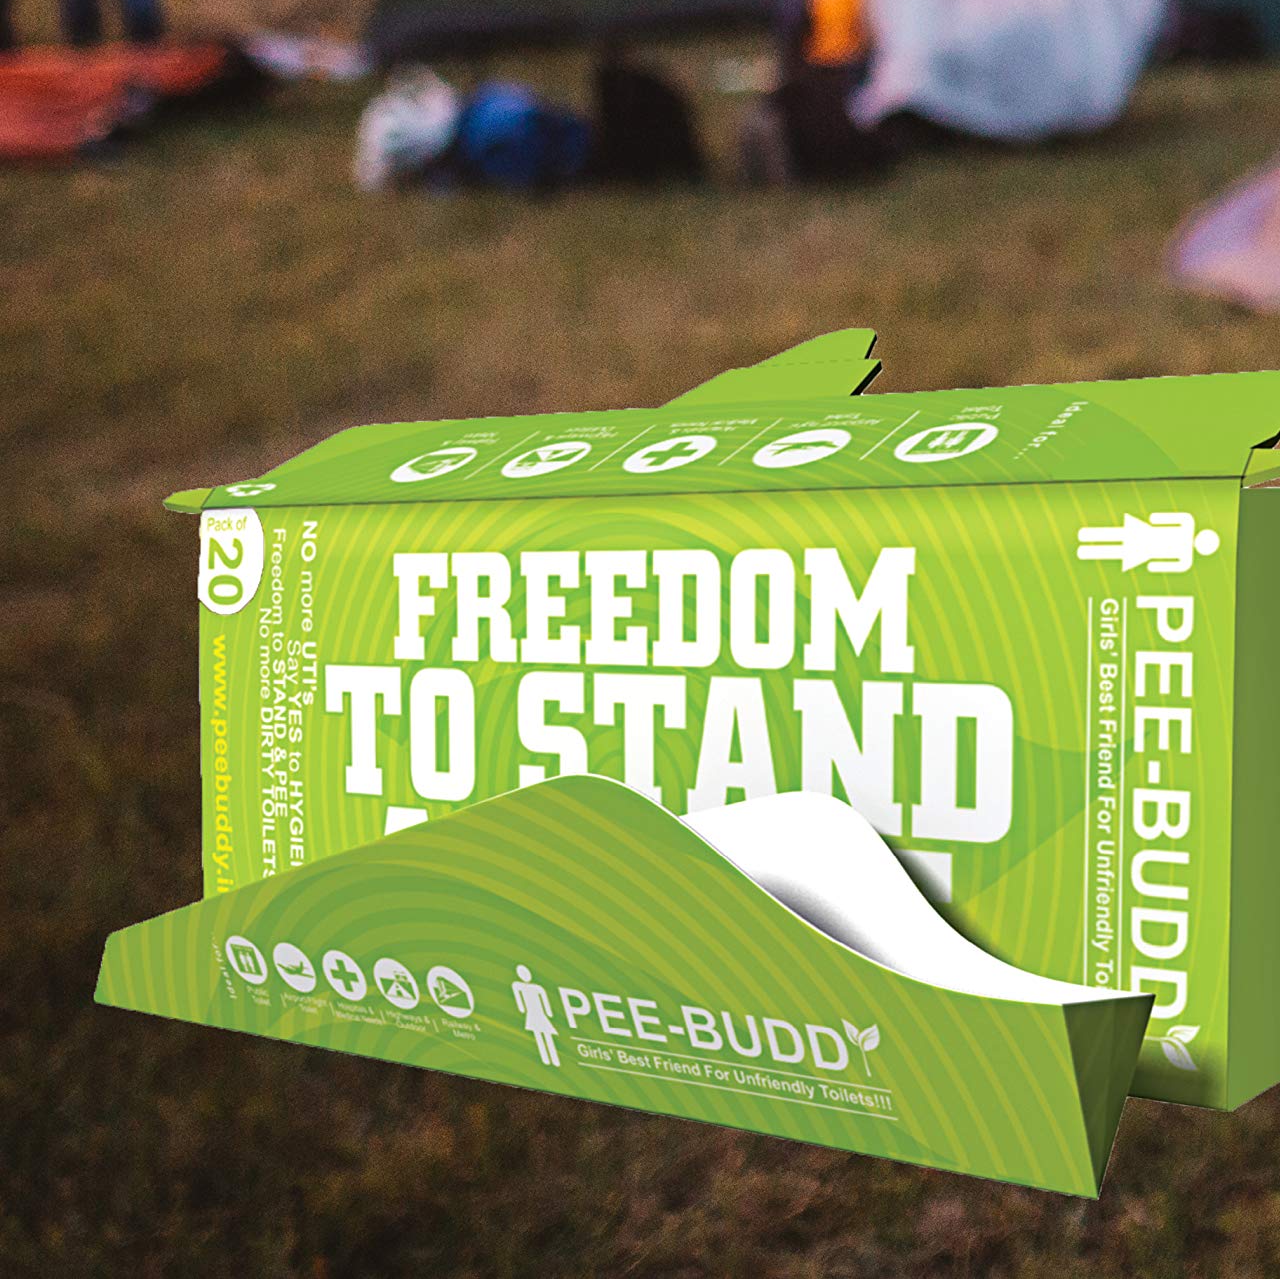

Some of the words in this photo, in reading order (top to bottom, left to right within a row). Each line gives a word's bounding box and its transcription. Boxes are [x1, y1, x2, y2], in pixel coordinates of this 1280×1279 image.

[206, 517, 232, 532] Pack
[235, 516, 247, 531] of
[301, 521, 318, 562] NO
[208, 537, 244, 606] 20
[271, 528, 286, 625] Freedom
[259, 608, 272, 638] No
[301, 571, 313, 632] more
[393, 547, 916, 673] FREEDOM
[1099, 597, 1120, 657] Girls'
[272, 632, 285, 652] to
[284, 640, 301, 684] Say
[260, 645, 271, 699] more
[272, 659, 287, 739] STAND
[301, 641, 318, 705] UTI's
[1098, 663, 1118, 713] Best
[261, 707, 275, 778] DIRTY
[288, 690, 303, 742] YES
[273, 747, 287, 763] &
[289, 752, 302, 772] to
[325, 664, 475, 802] TO
[517, 670, 1014, 844] STAND
[1097, 719, 1117, 789] Friend
[274, 770, 288, 817] PEE
[1096, 797, 1116, 834] For
[1091, 841, 1115, 953] Unfriendly
[1095, 959, 1114, 989] To
[577, 1043, 615, 1064] Girls'
[617, 1050, 652, 1070] Best
[654, 1057, 701, 1078] Friend
[705, 1065, 731, 1083] For
[733, 1069, 815, 1100] Unfriendly
[820, 1084, 893, 1111] Toilets!!!
